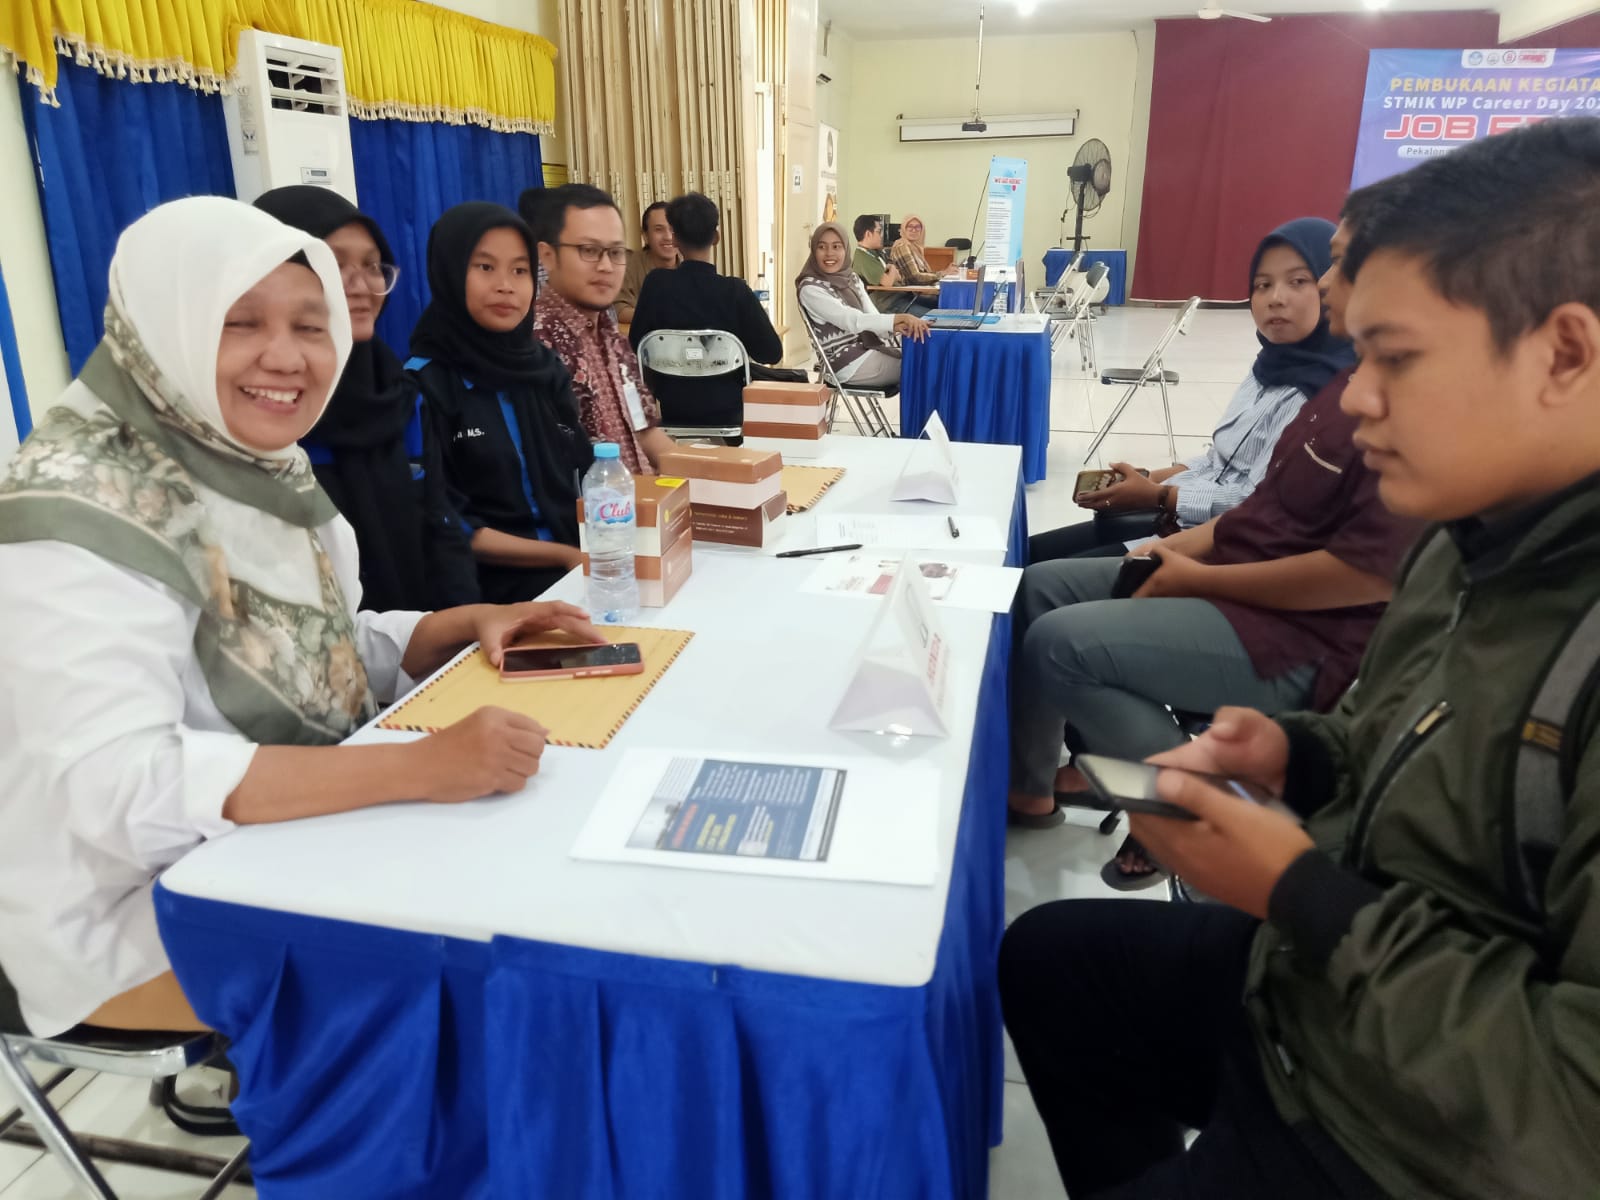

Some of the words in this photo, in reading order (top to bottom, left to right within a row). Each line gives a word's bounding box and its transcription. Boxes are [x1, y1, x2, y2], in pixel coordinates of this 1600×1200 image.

[1389, 77, 1512, 92] PEMBUKAAN
[1383, 96, 1435, 109] STMIK
[1441, 96, 1468, 109] WP
[1472, 96, 1531, 109] Career
[1536, 96, 1570, 112] Day
[1384, 114, 1479, 140] JOB
[599, 501, 631, 519] Club
